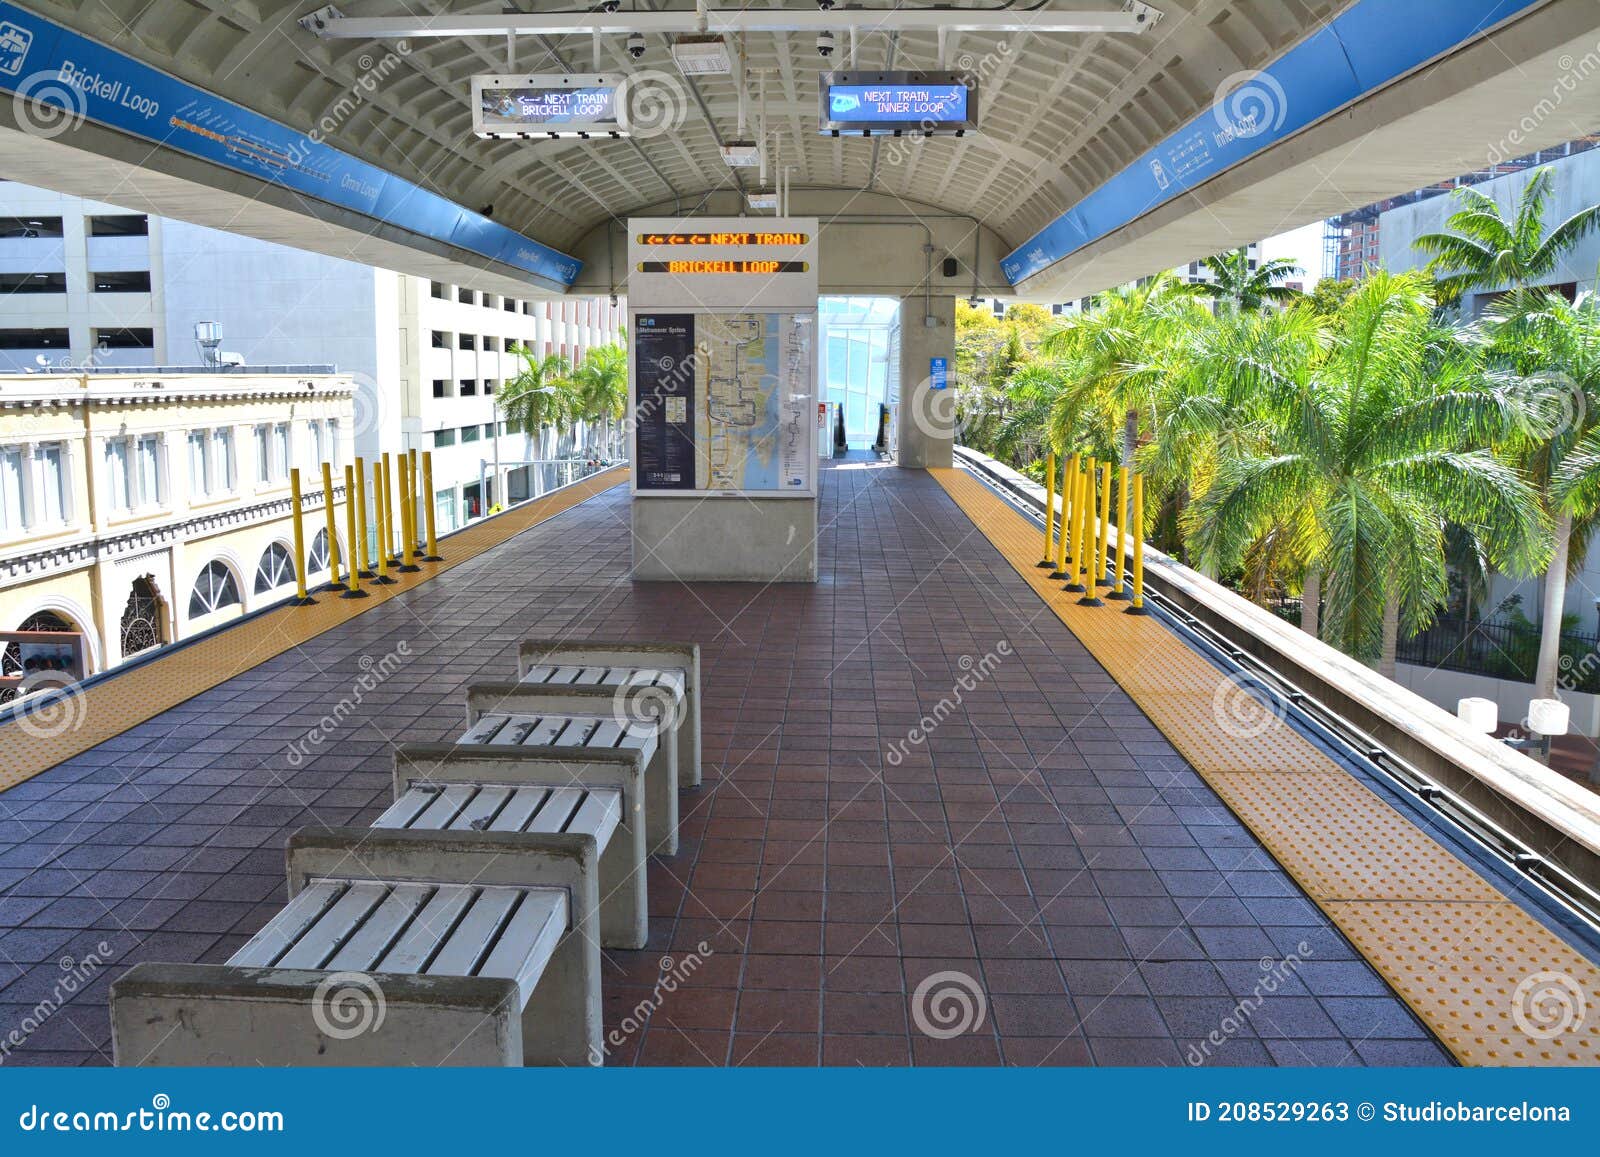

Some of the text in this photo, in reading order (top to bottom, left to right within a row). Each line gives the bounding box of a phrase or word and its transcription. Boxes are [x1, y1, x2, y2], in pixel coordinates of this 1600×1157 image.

[57, 60, 121, 102] Brickell
[121, 86, 159, 119] Loop
[544, 94, 608, 104] NEXT TRAIN
[864, 91, 929, 102] NEXT TRAIN
[522, 105, 603, 116] BRICKELL LOOP
[877, 103, 944, 113] INNER LOOP
[1213, 126, 1233, 148] Inner
[1231, 114, 1257, 136] Loop
[710, 233, 801, 245] NEXT TRAIN
[669, 261, 779, 274] BRICKELL LOOP
